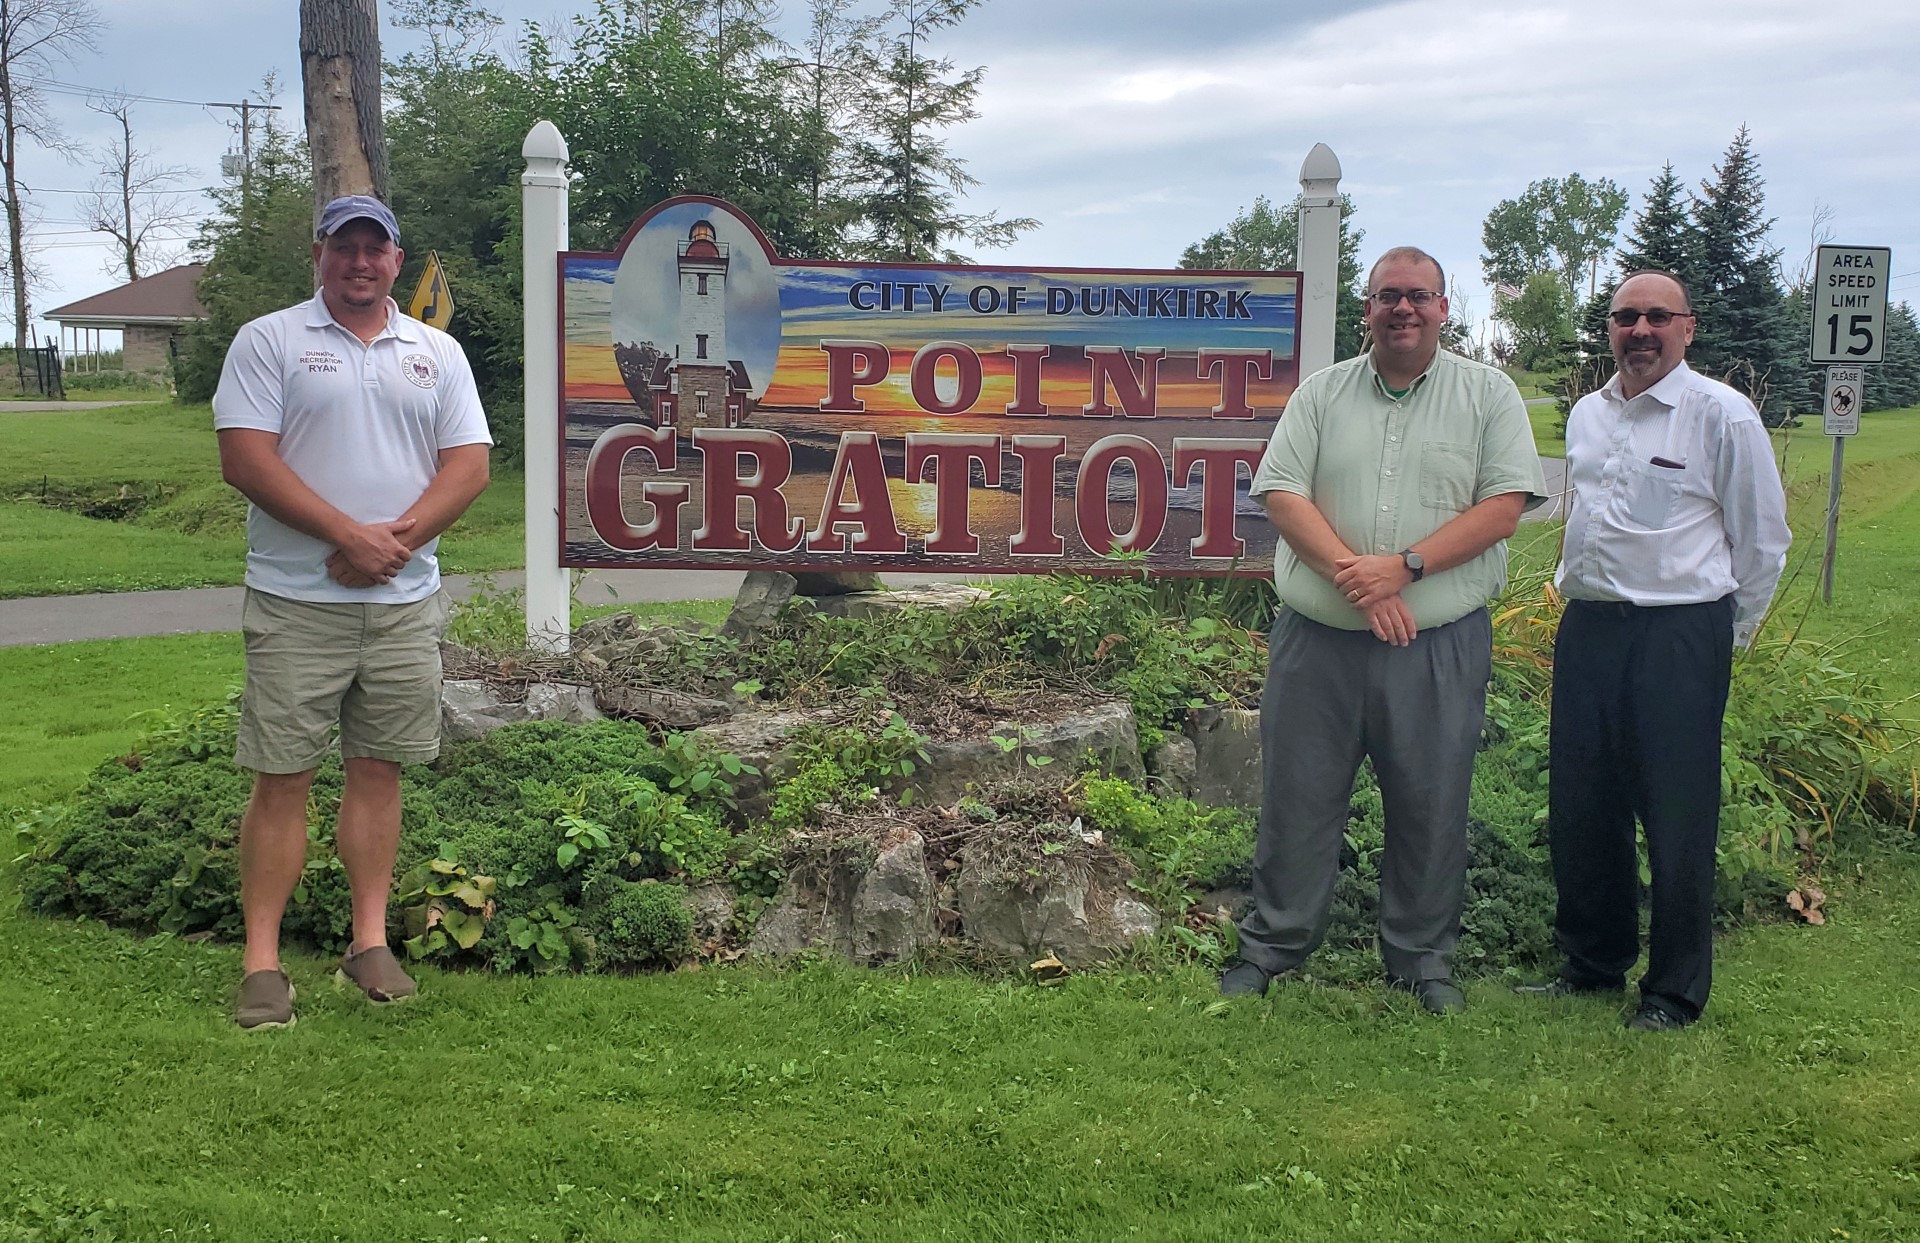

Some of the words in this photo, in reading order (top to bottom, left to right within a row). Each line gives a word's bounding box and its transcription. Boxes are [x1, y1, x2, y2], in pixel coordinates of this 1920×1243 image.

[1833, 254, 1874, 268] AREA
[1828, 274, 1876, 288] SPEED
[847, 281, 952, 313] CITY
[967, 284, 1027, 315] OF
[1045, 286, 1253, 319] DUNKIRK
[1831, 294, 1870, 308] LIMIT
[1827, 313, 1874, 356] 15
[308, 364, 337, 373] RYAN
[819, 339, 1273, 420] POINT
[1831, 372, 1859, 381] PLEASE
[585, 423, 1269, 560] GRATIOT
